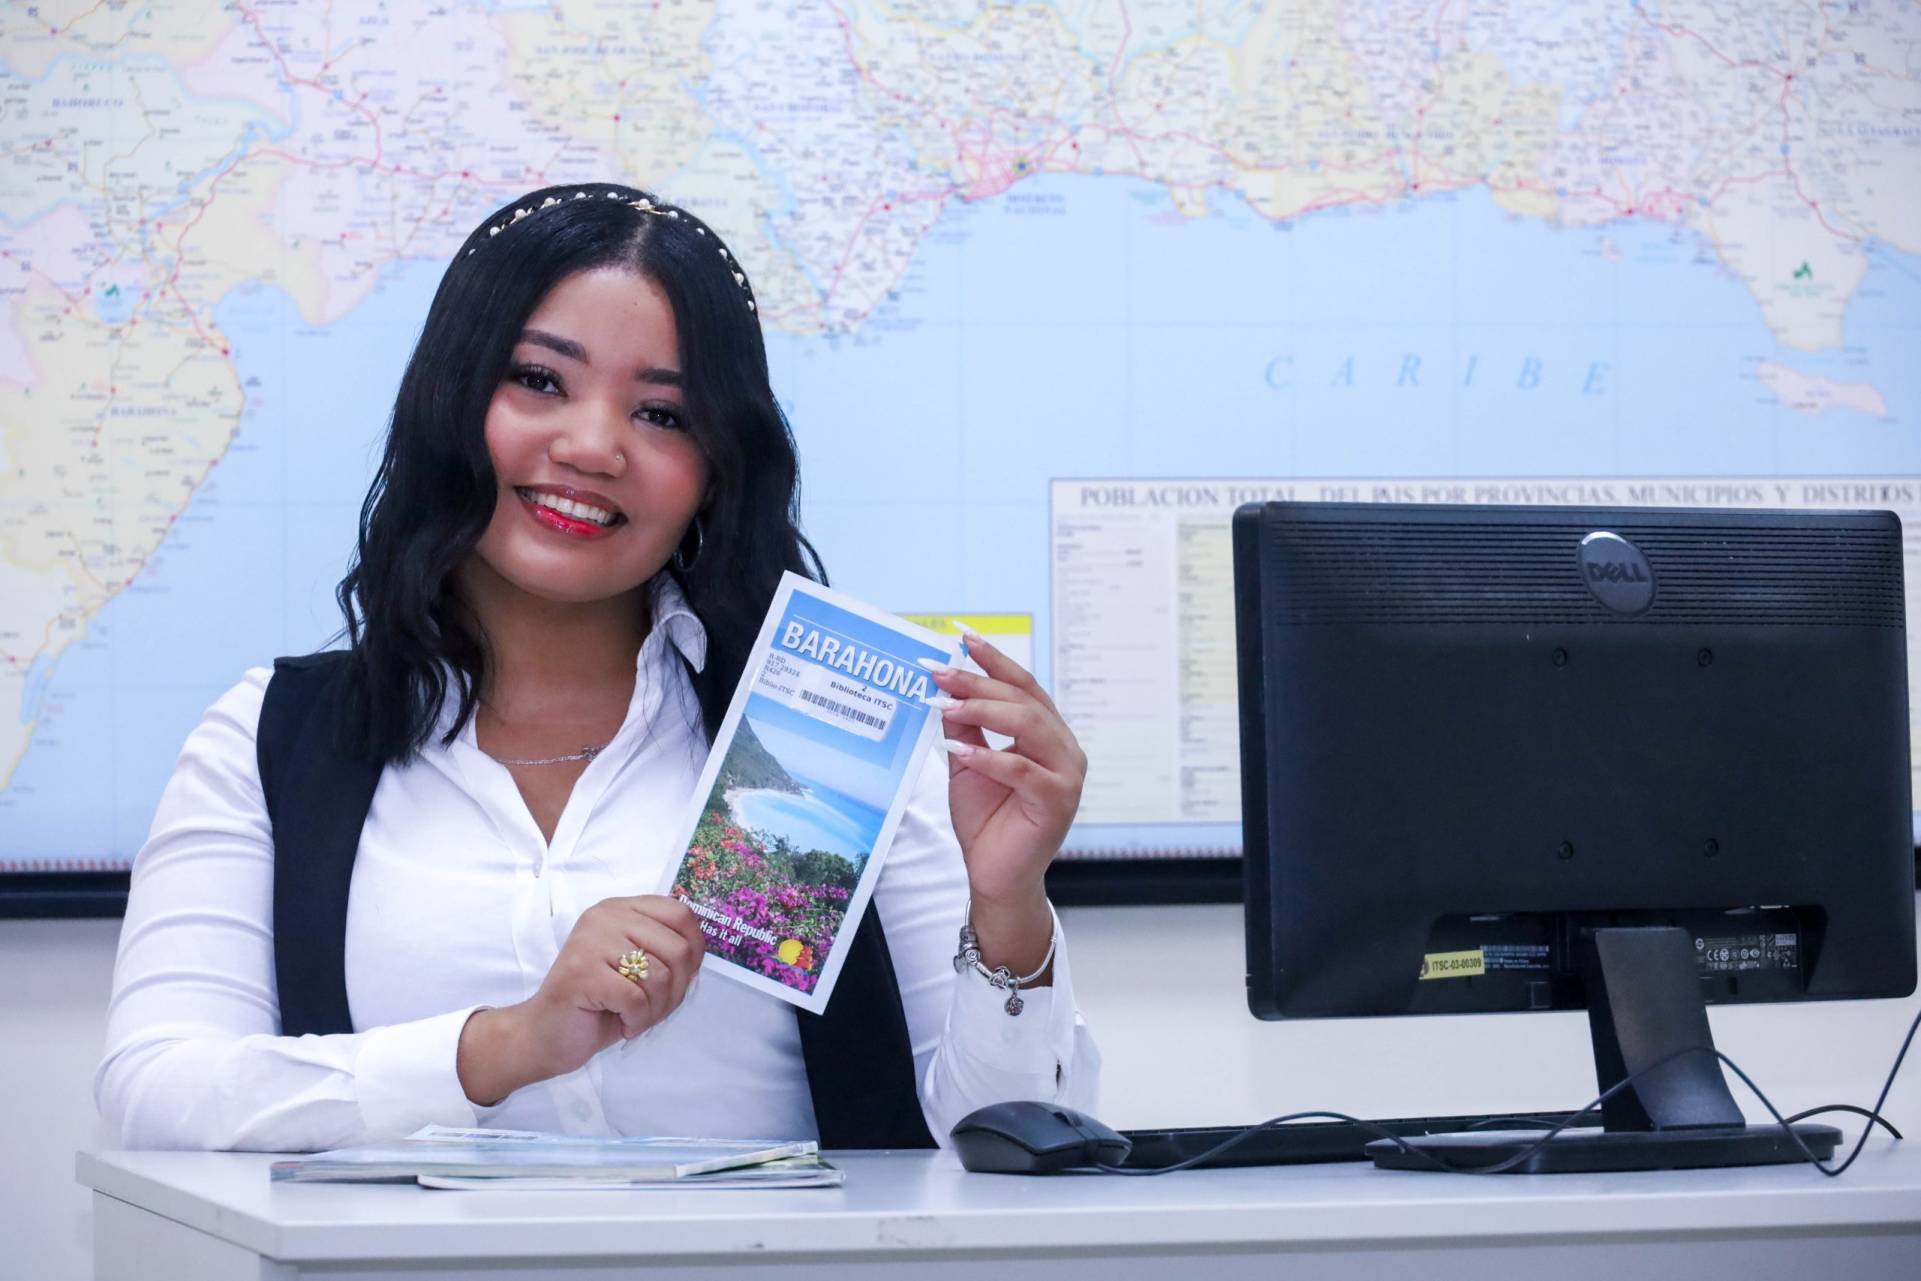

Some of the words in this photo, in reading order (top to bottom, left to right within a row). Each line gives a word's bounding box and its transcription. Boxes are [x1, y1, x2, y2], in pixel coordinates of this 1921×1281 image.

[1081, 487, 1220, 507] POBLACION
[1628, 485, 1764, 503] MUNICIPIOS
[1775, 485, 1791, 503] Y
[1802, 484, 1913, 503] DISTRITOS
[1586, 561, 1649, 584] DELL
[782, 621, 929, 704] BARAHONA
[830, 681, 872, 703] Biblioteca
[873, 697, 894, 711] ITSC
[700, 920, 717, 937] Has
[729, 935, 743, 947] all
[732, 917, 778, 946] Republic
